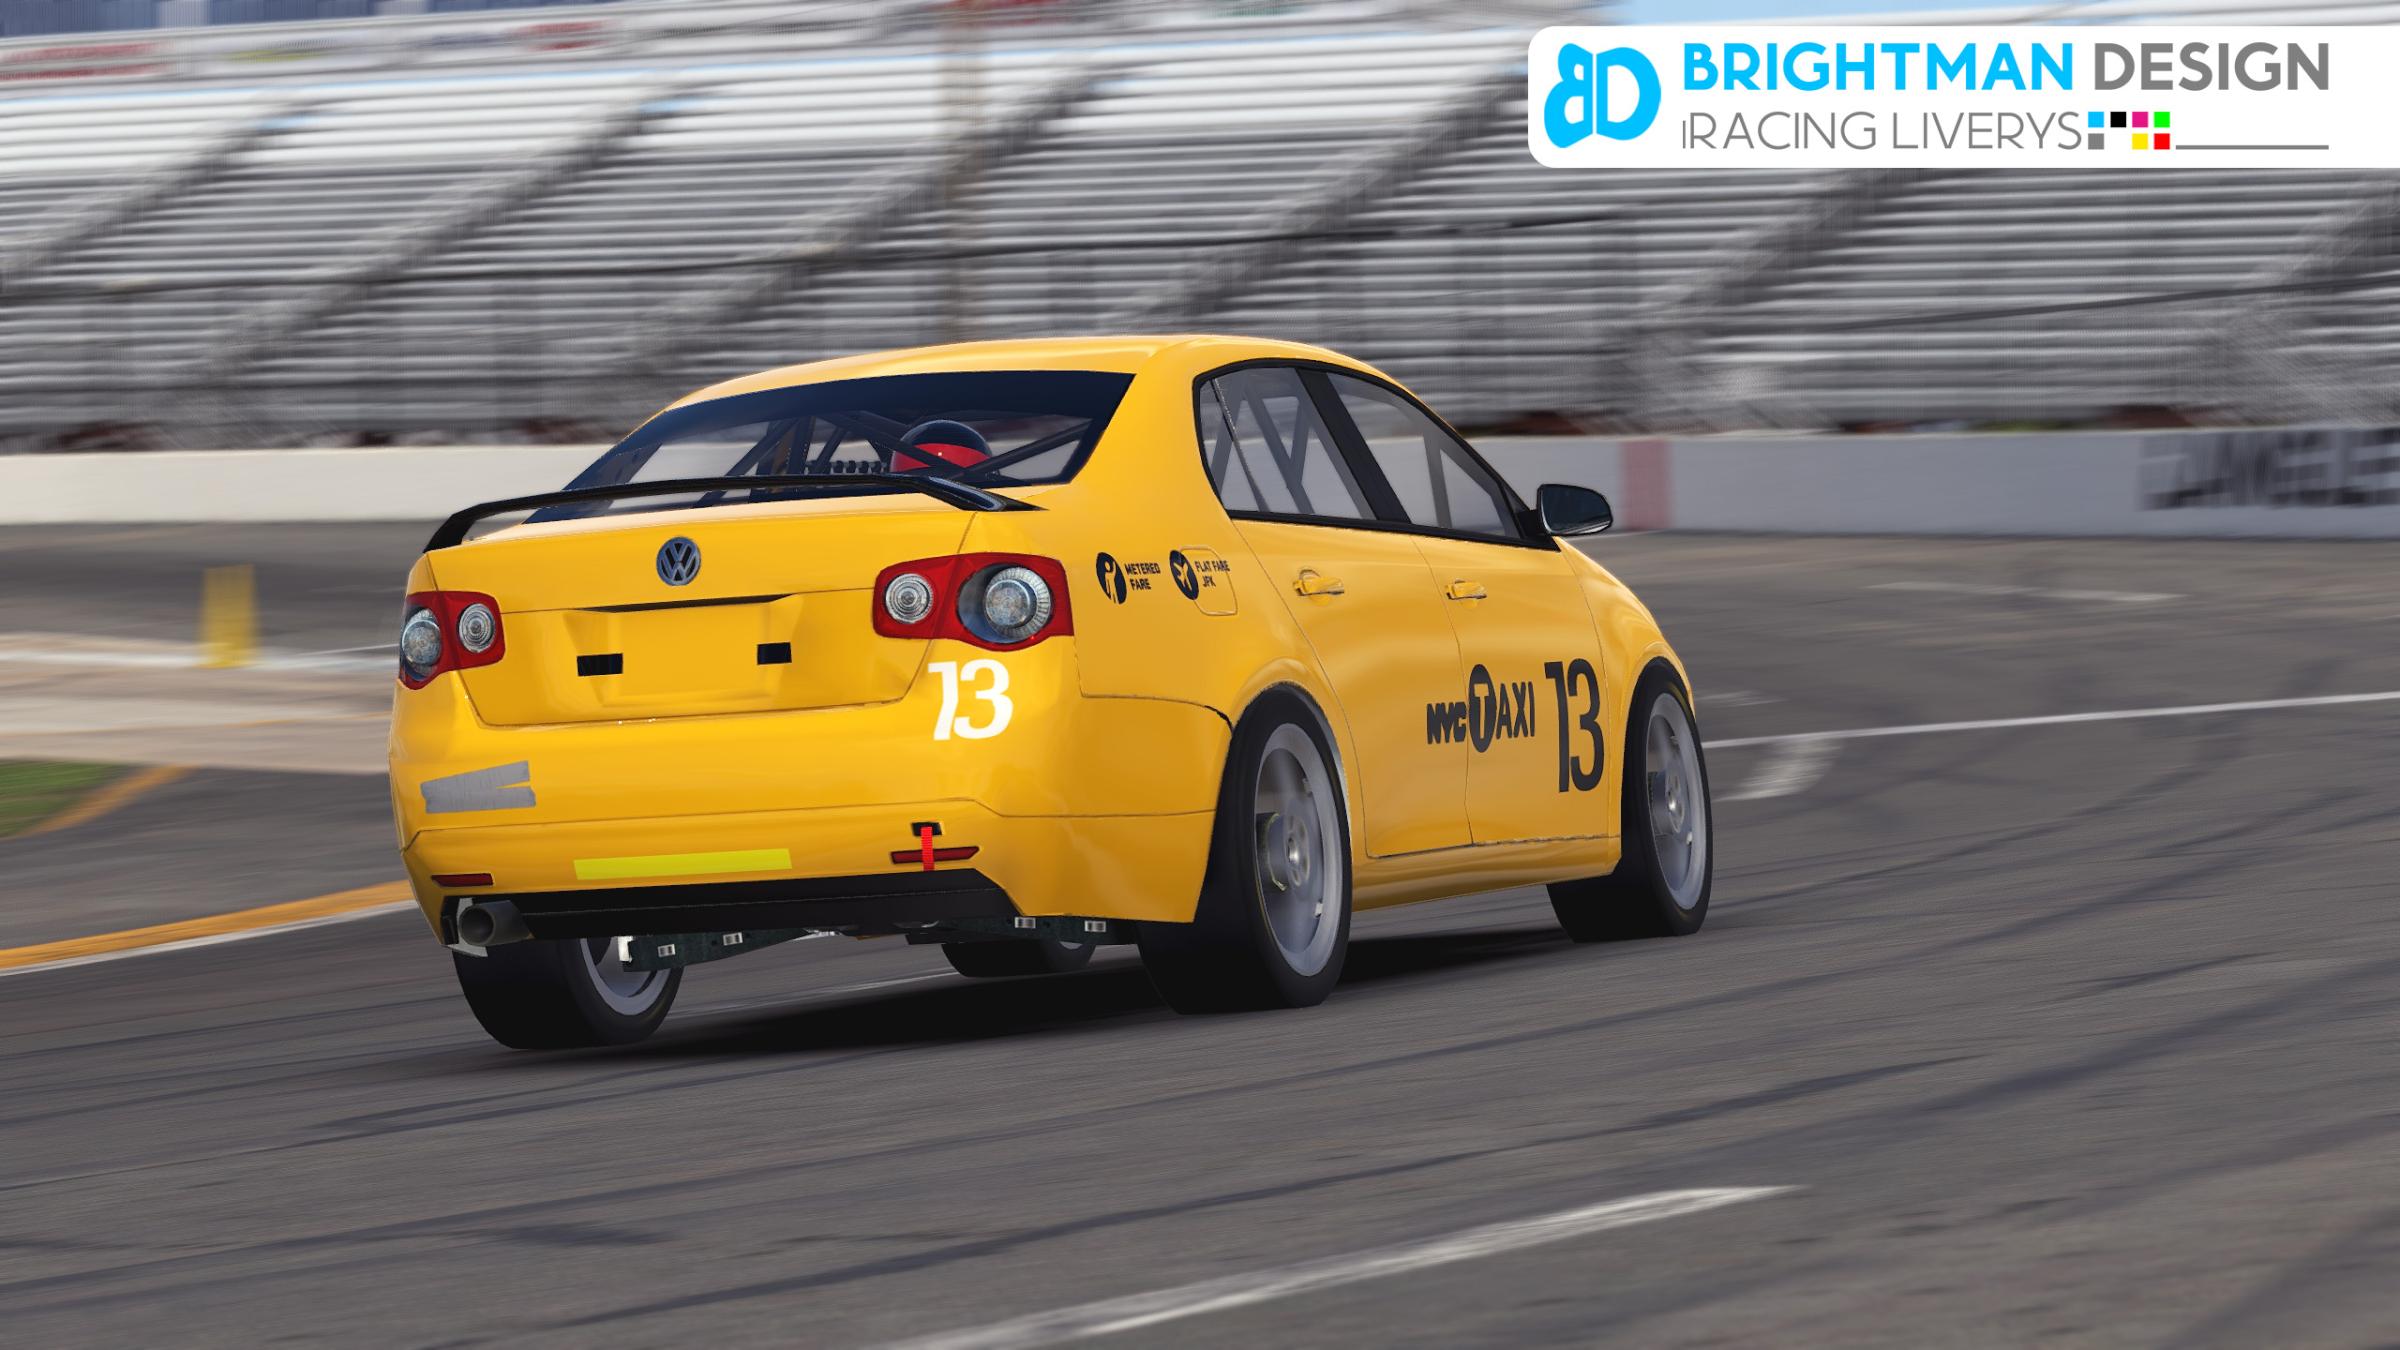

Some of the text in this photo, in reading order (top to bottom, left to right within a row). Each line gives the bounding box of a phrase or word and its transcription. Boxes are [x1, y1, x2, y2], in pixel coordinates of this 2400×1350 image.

[1125, 562, 1161, 575] METERED
[1194, 560, 1231, 573] FLAT FARE
[1129, 578, 1152, 591] FARE
[1202, 576, 1217, 588] JFK
[927, 658, 1014, 741] 13
[1426, 663, 1536, 753] NYC TAXI
[1543, 657, 1605, 793] 13
